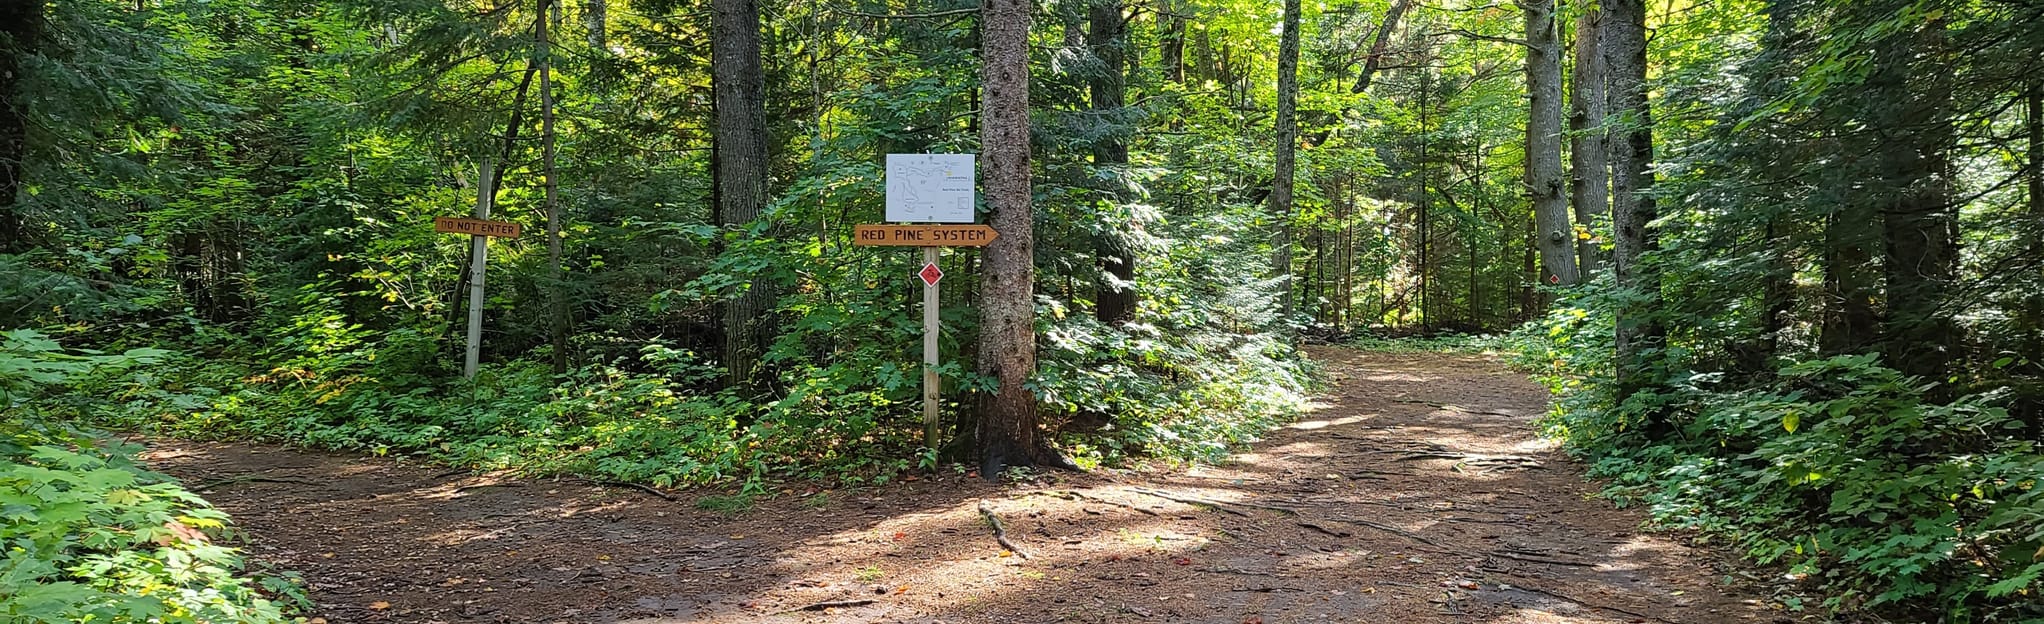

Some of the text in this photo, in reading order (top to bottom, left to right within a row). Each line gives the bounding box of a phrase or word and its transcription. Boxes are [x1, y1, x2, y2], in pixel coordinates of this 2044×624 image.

[441, 220, 514, 235] DO NOT ENTER
[861, 229, 986, 241] RED PINE SYSTEM
